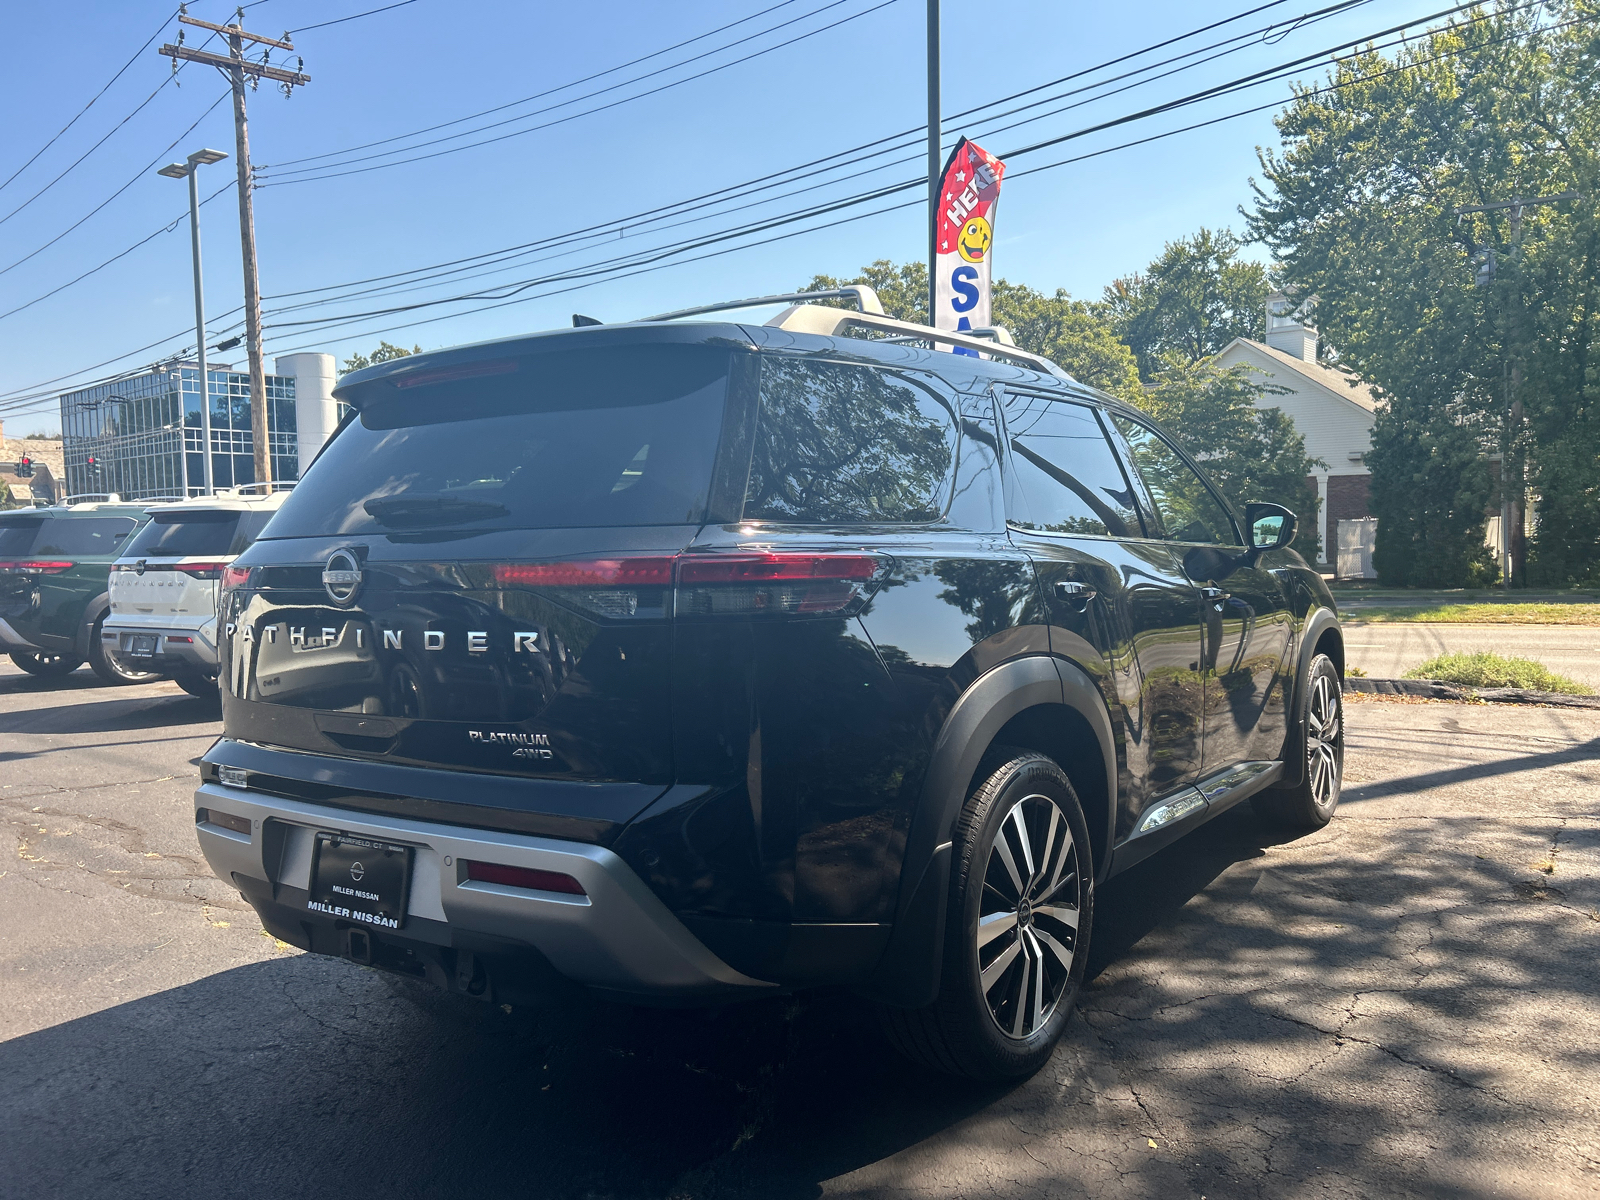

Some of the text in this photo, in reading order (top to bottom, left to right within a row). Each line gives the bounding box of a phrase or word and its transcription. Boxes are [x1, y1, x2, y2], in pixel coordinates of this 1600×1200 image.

[947, 163, 1000, 228] HERE
[226, 623, 540, 652] PATHFINDER
[468, 730, 550, 746] PLATINUM
[512, 748, 554, 760] 4WD
[332, 885, 379, 901] MILLER NISSAN
[308, 901, 398, 928] MILLER NISSAN
